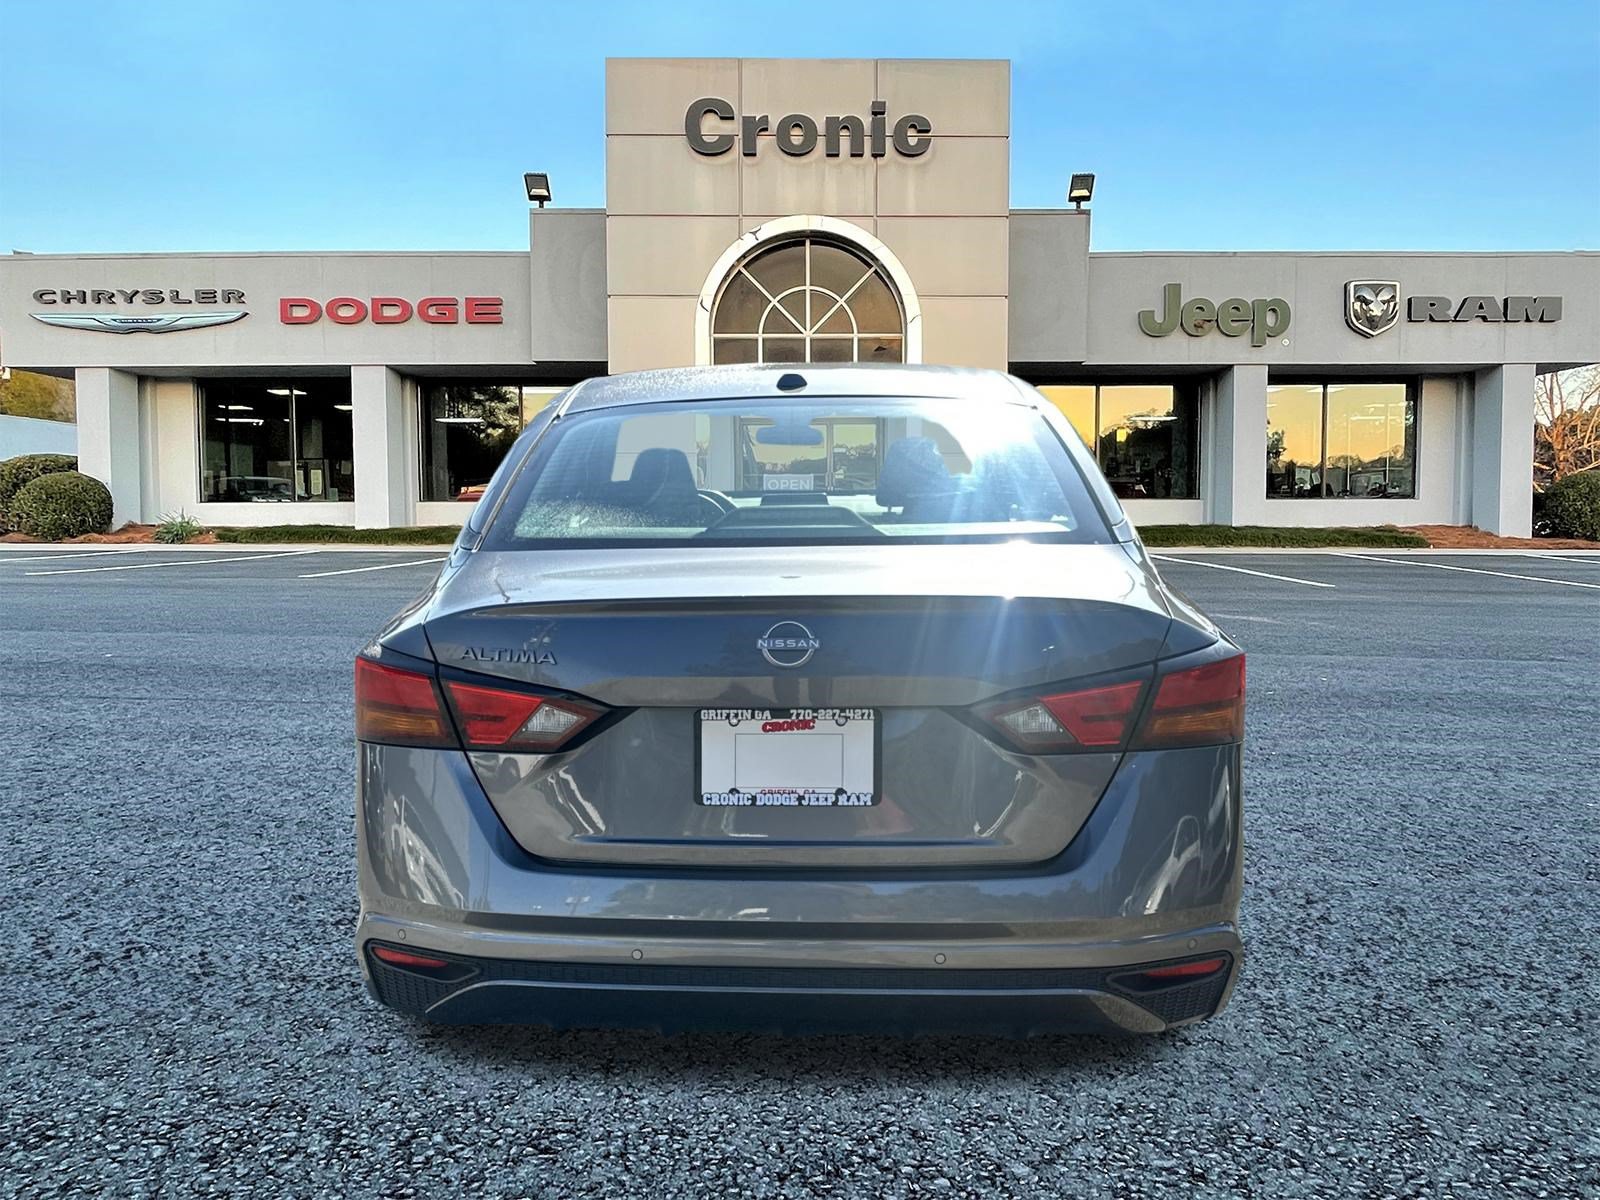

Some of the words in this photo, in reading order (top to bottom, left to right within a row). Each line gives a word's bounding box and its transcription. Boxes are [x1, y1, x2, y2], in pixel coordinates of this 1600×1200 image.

[685, 97, 932, 157] Cronic
[32, 288, 247, 305] CHRYSLER
[280, 296, 504, 324] DODGE
[1138, 283, 1292, 347] Jeep
[1407, 296, 1563, 323] RAM
[767, 479, 810, 490] OPEN
[757, 639, 820, 649] NISSAN
[460, 647, 557, 665] ALTIMA
[701, 709, 752, 720] GRIFFIN
[754, 709, 772, 720] GA
[790, 708, 875, 720] 770-227-4271
[761, 720, 816, 732] CRONIC
[702, 793, 752, 806] CRONIC
[755, 793, 799, 806] DODGE
[801, 793, 835, 806] JEEP
[837, 793, 872, 806] RAM
